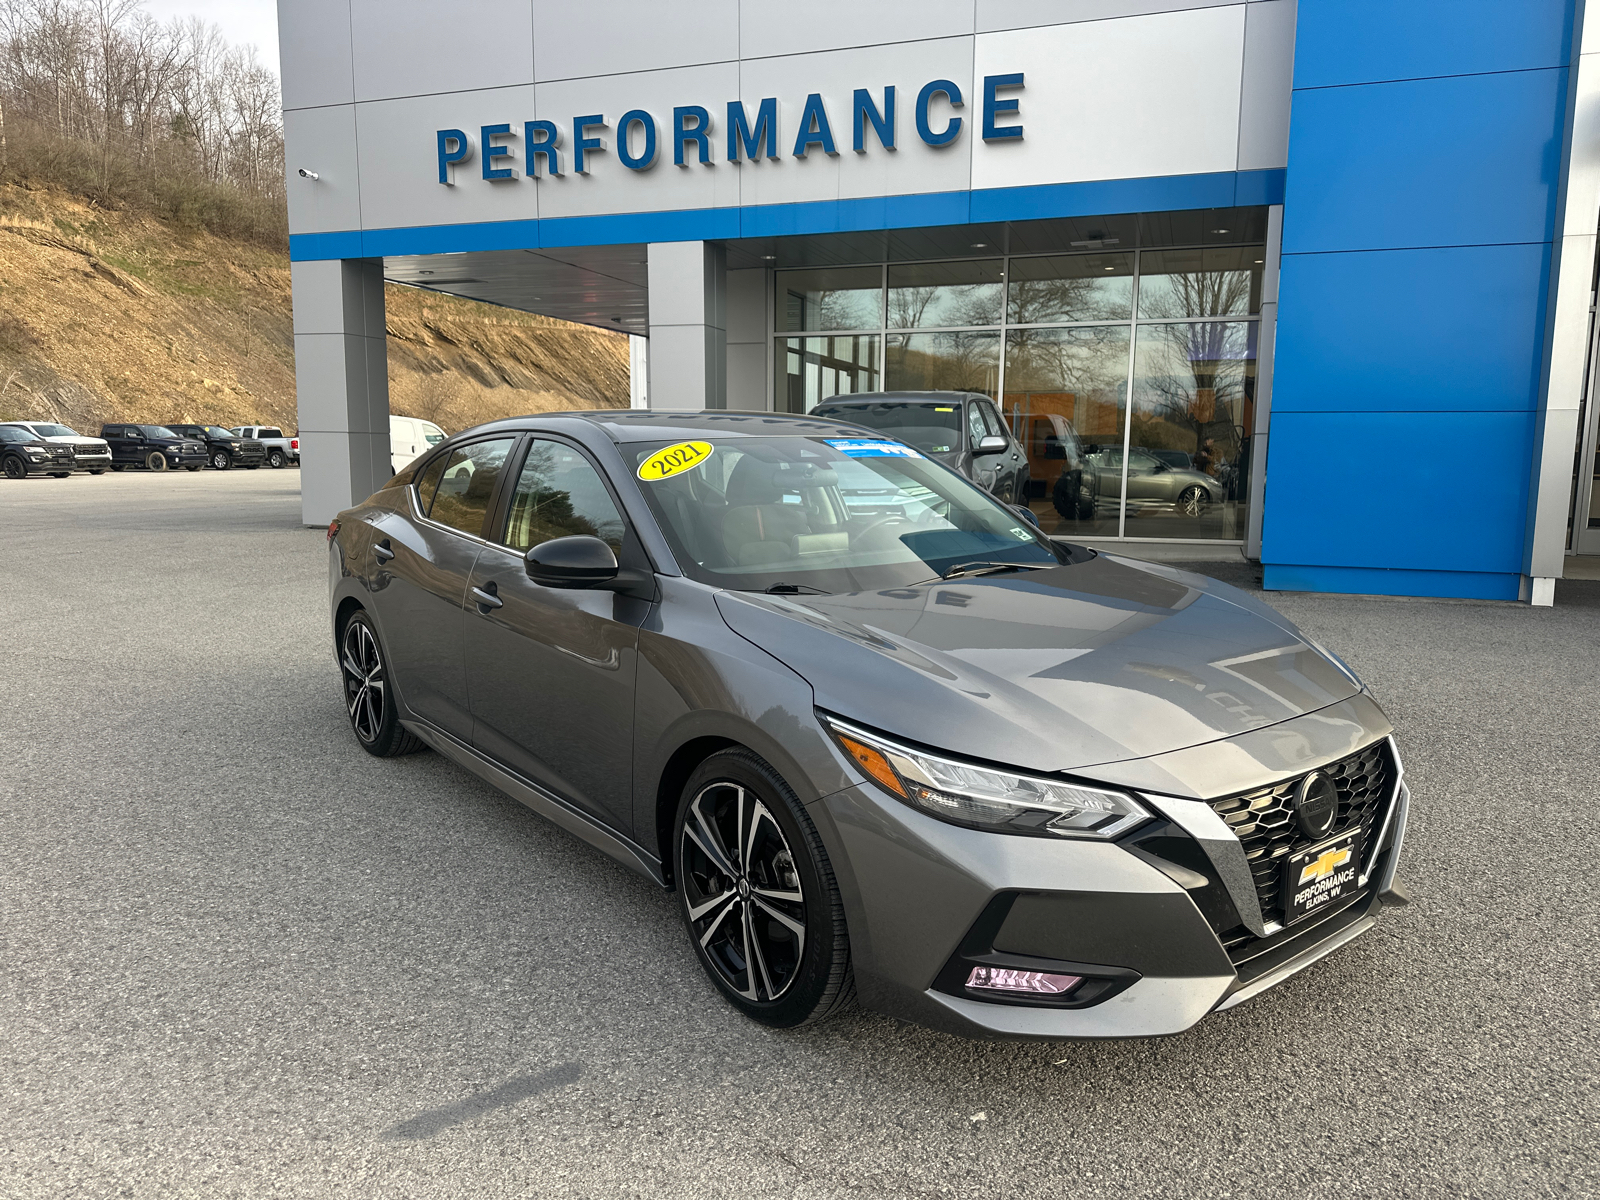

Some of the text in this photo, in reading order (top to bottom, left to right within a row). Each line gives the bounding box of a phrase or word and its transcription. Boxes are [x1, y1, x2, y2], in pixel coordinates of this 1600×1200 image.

[436, 73, 1025, 186] PERFORMANCE
[652, 444, 704, 475] 2021
[1306, 797, 1334, 813] NISSAN
[1294, 866, 1354, 906] PERFORMANCE
[1306, 892, 1330, 910] ELKINS,
[1331, 886, 1341, 897] WV
